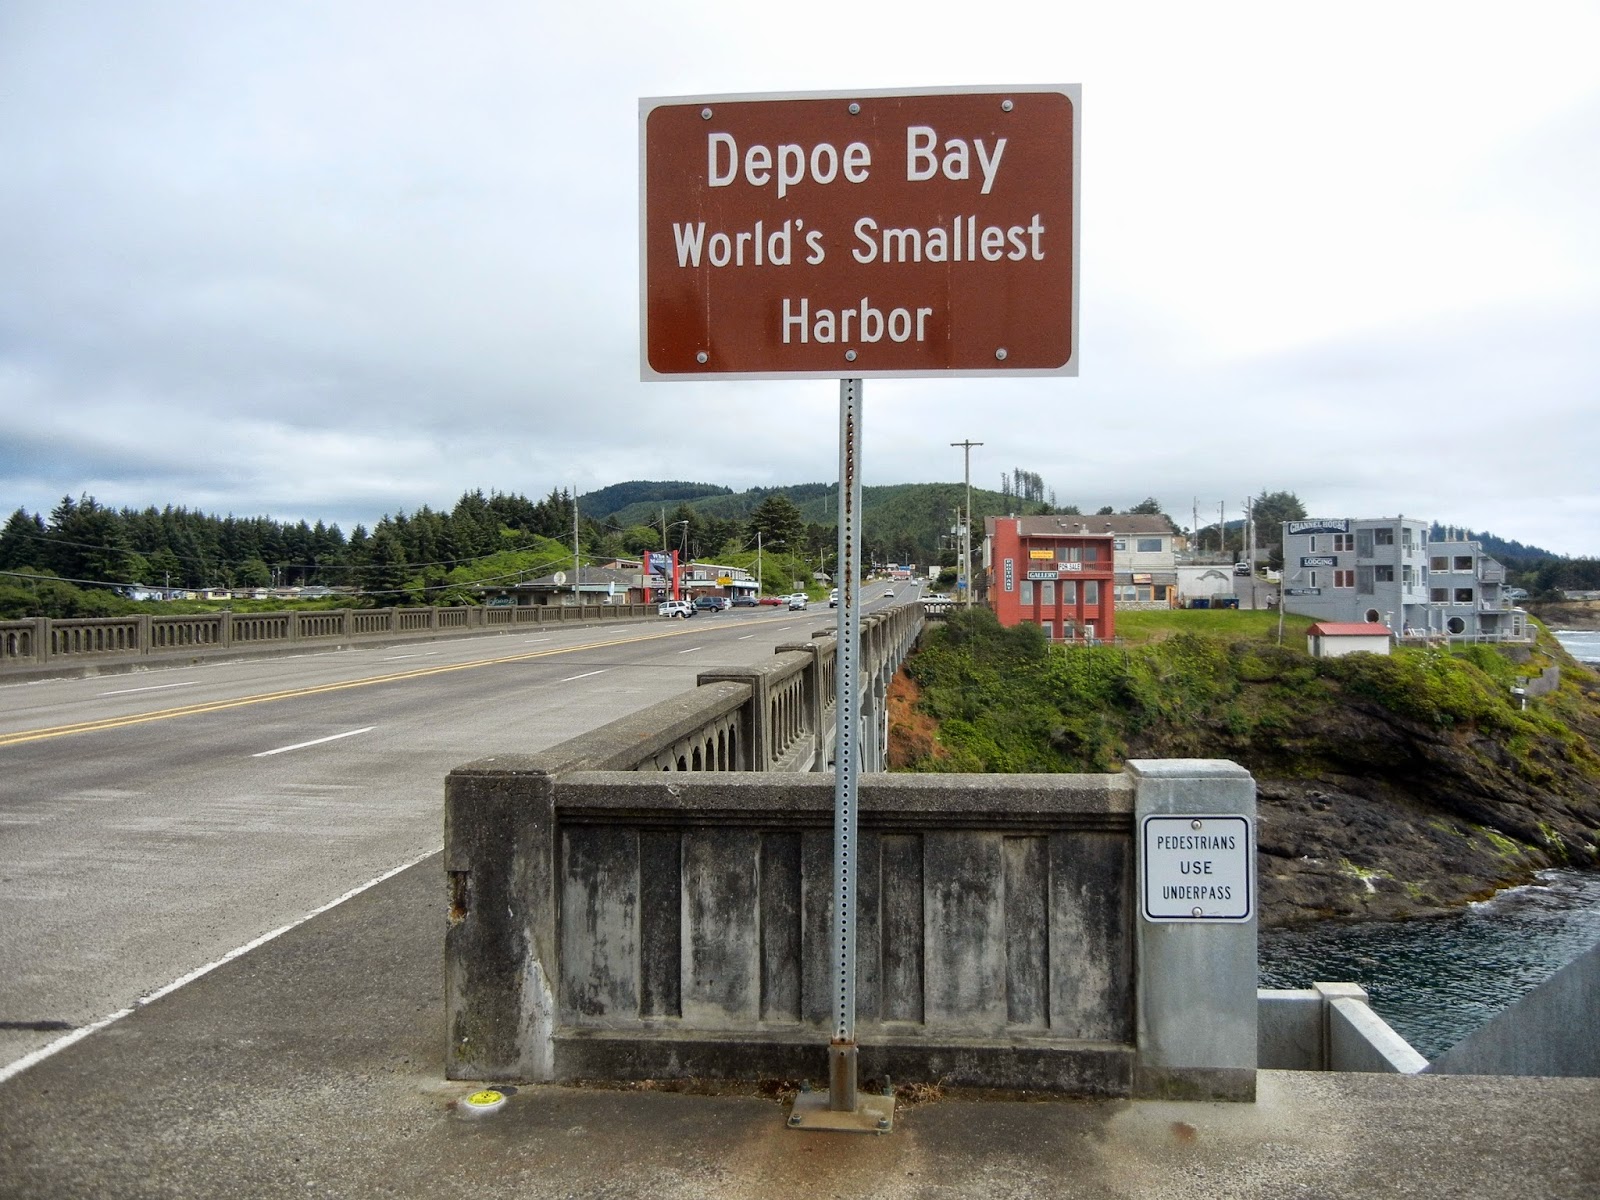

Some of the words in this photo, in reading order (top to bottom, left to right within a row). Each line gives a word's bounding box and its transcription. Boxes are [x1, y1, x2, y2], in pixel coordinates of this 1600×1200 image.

[708, 132, 872, 199] Depoe
[906, 126, 1008, 195] Bay
[673, 219, 826, 268] World's
[852, 214, 1046, 264] Smallest
[782, 297, 933, 344] Harbor
[1290, 522, 1321, 533] CHANNEL
[1322, 520, 1346, 532] HOUSE
[1304, 558, 1333, 566] LODGING
[1157, 836, 1236, 850] PEDESTRIANS
[1180, 861, 1213, 875] USE
[1162, 886, 1232, 900] UNDERPASS
